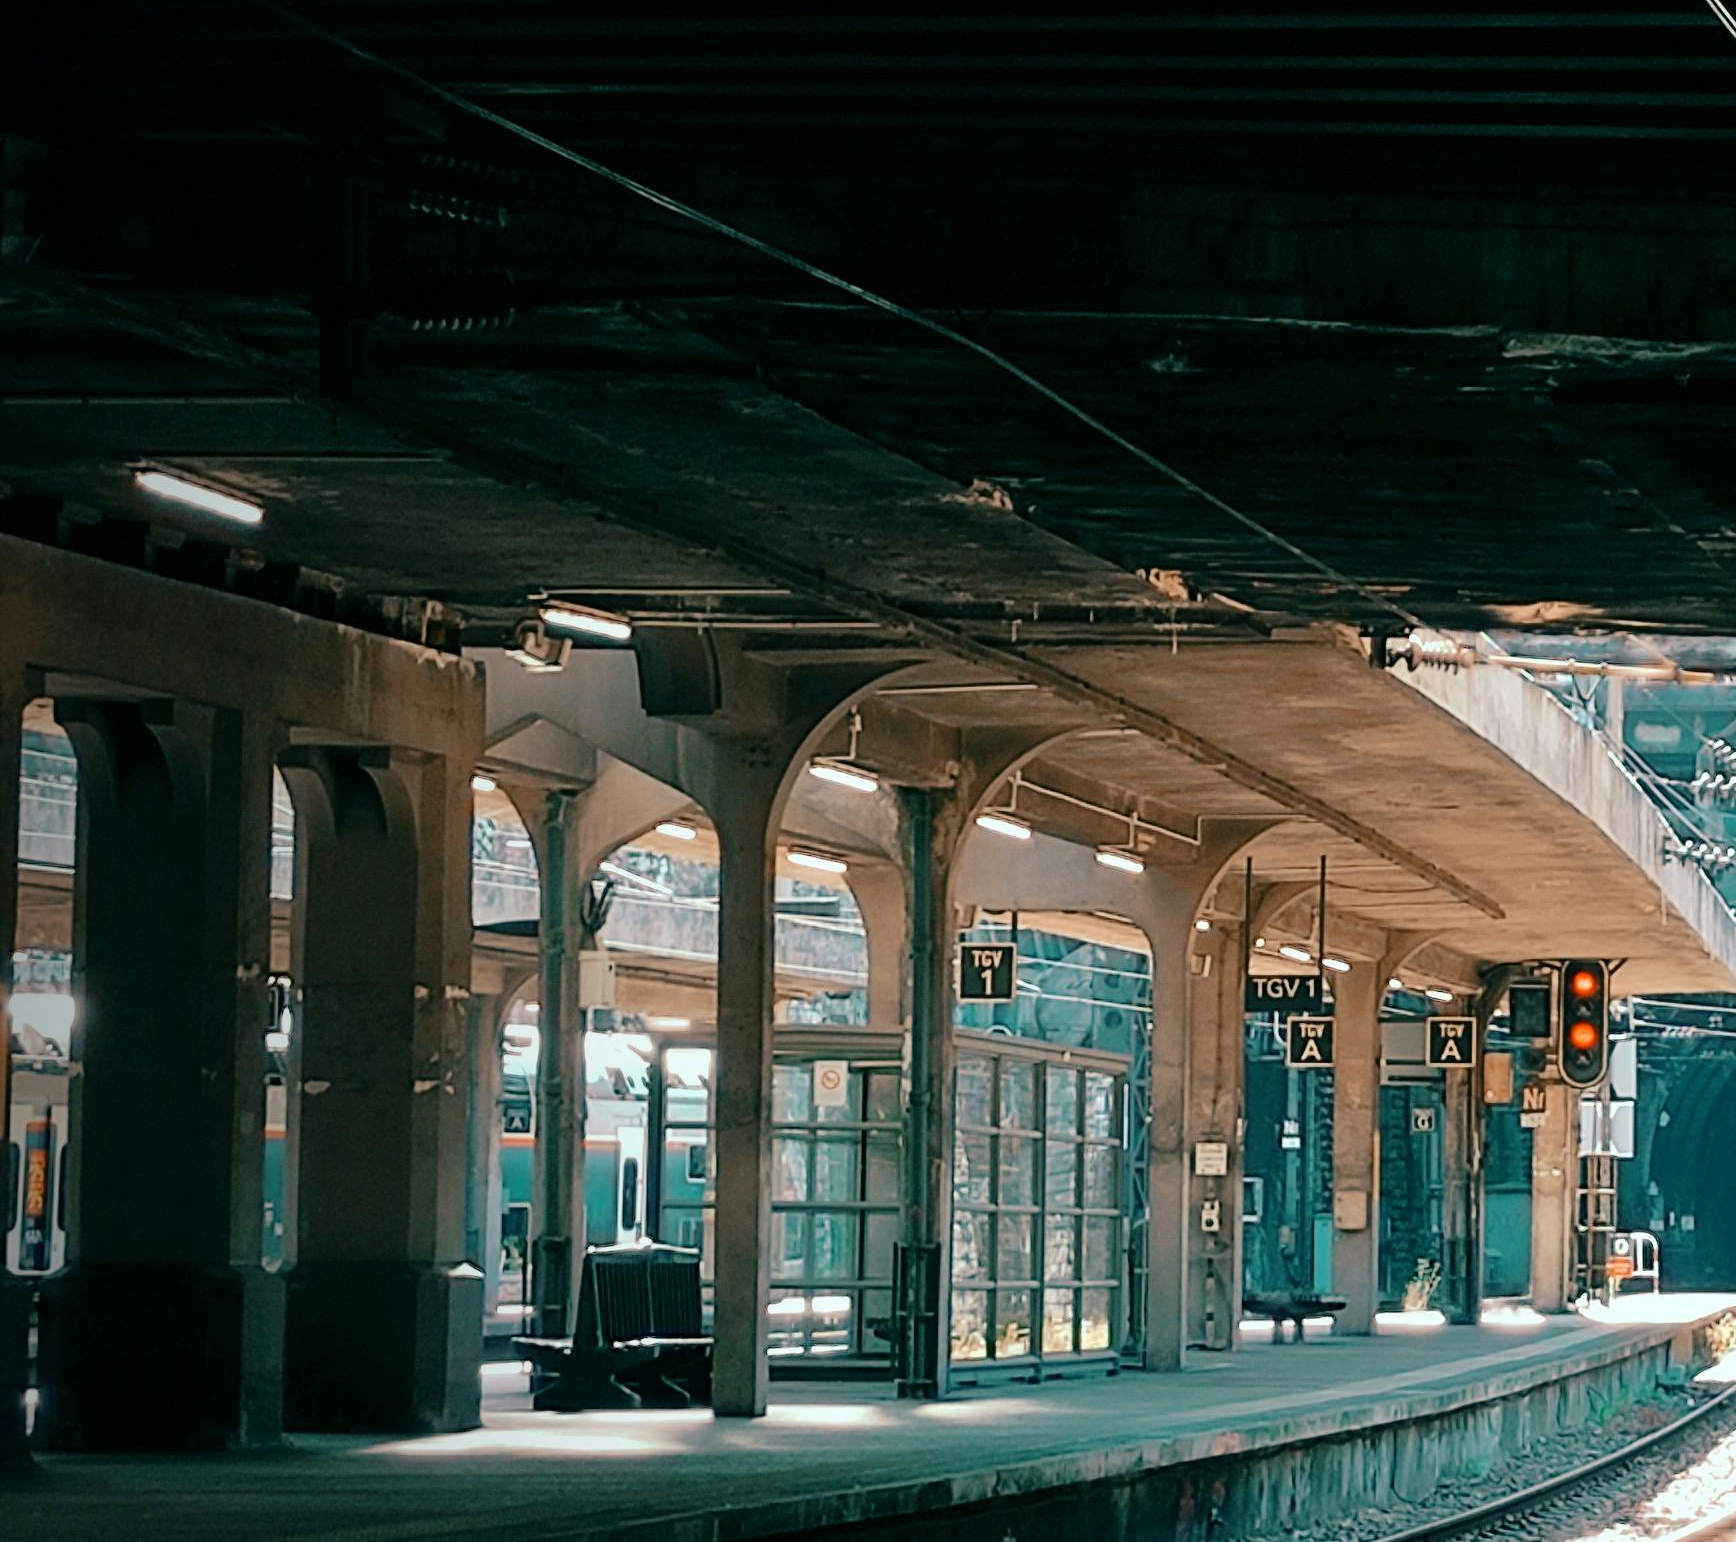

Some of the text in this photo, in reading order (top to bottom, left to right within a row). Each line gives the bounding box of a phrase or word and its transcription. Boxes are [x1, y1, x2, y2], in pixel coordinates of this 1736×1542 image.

[971, 950, 1003, 968] TGV
[981, 969, 992, 996] 1
[1252, 978, 1315, 998] TGV 1
[1300, 1038, 1322, 1061] A
[1440, 1038, 1462, 1061] A
